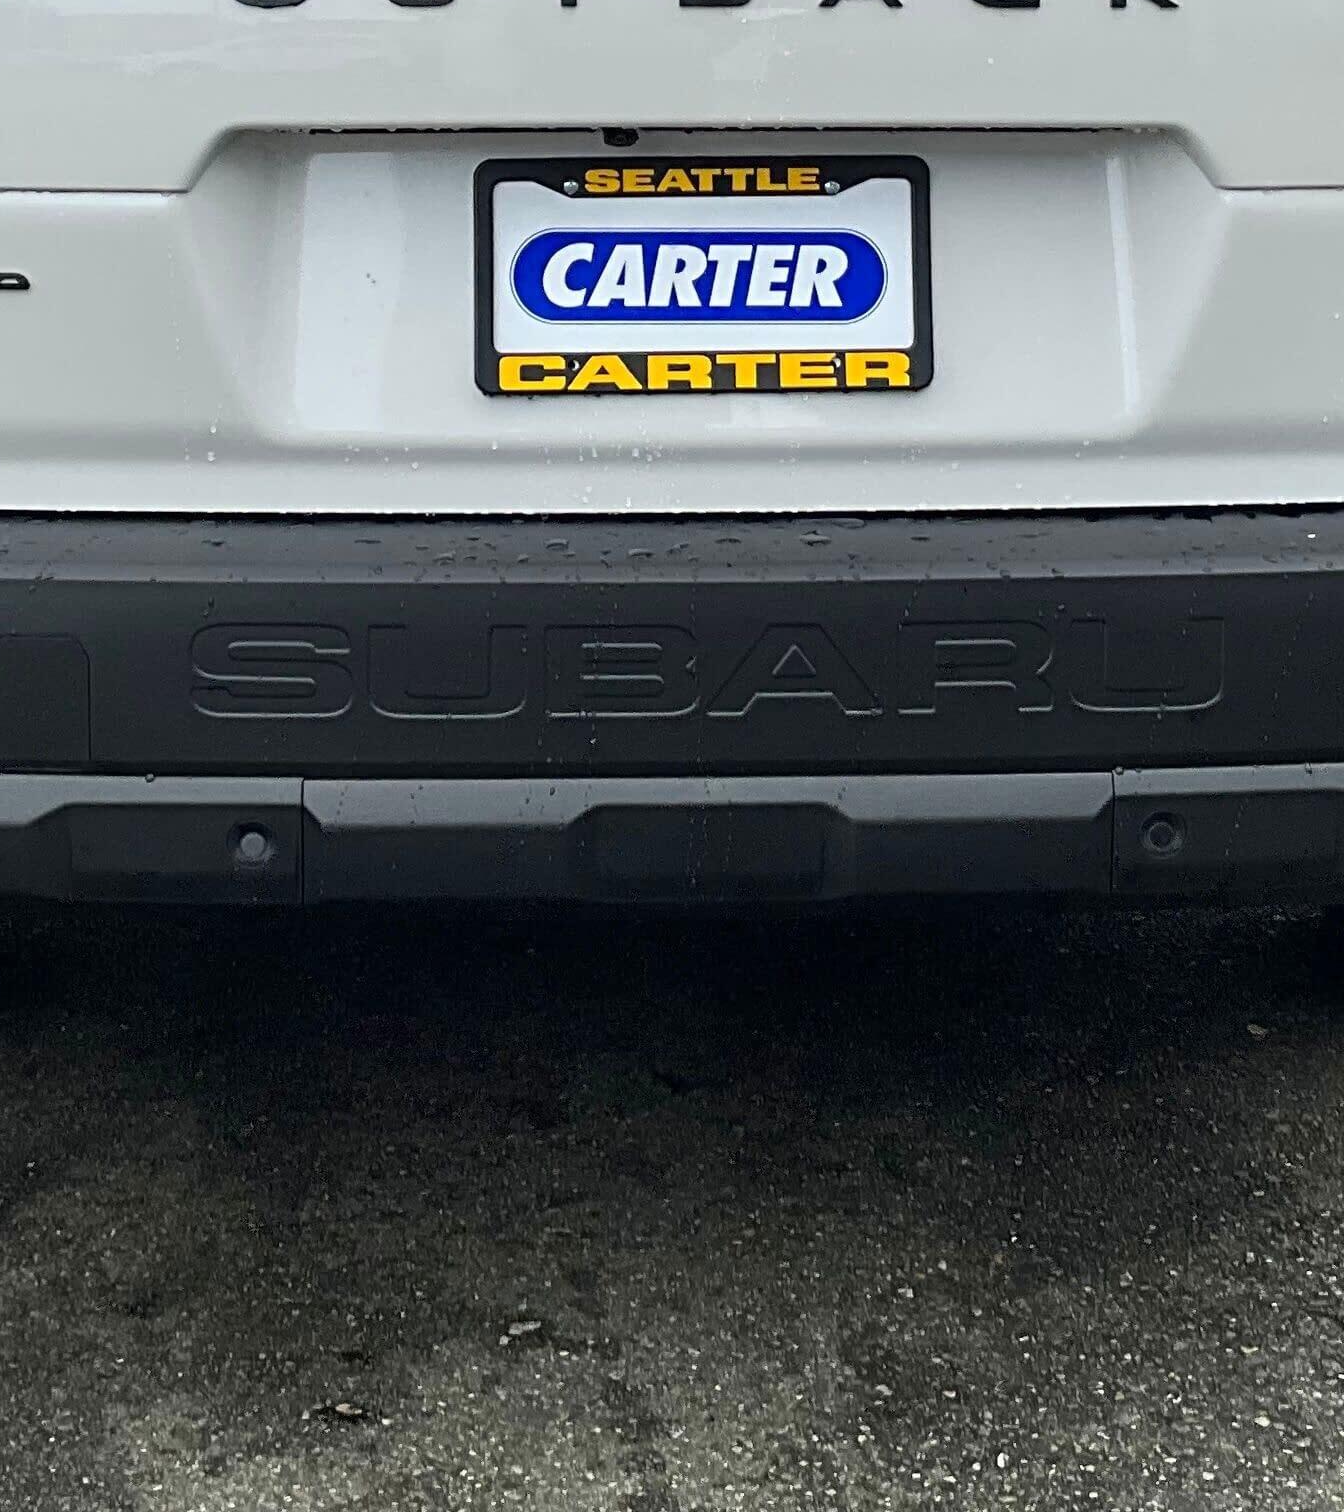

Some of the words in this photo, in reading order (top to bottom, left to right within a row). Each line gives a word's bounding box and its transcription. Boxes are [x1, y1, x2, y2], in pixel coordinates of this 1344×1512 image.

[584, 167, 820, 192] SEATTLE
[542, 242, 848, 308] CARTER
[499, 352, 912, 390] CARTER
[188, 617, 1227, 719] SUBARU
